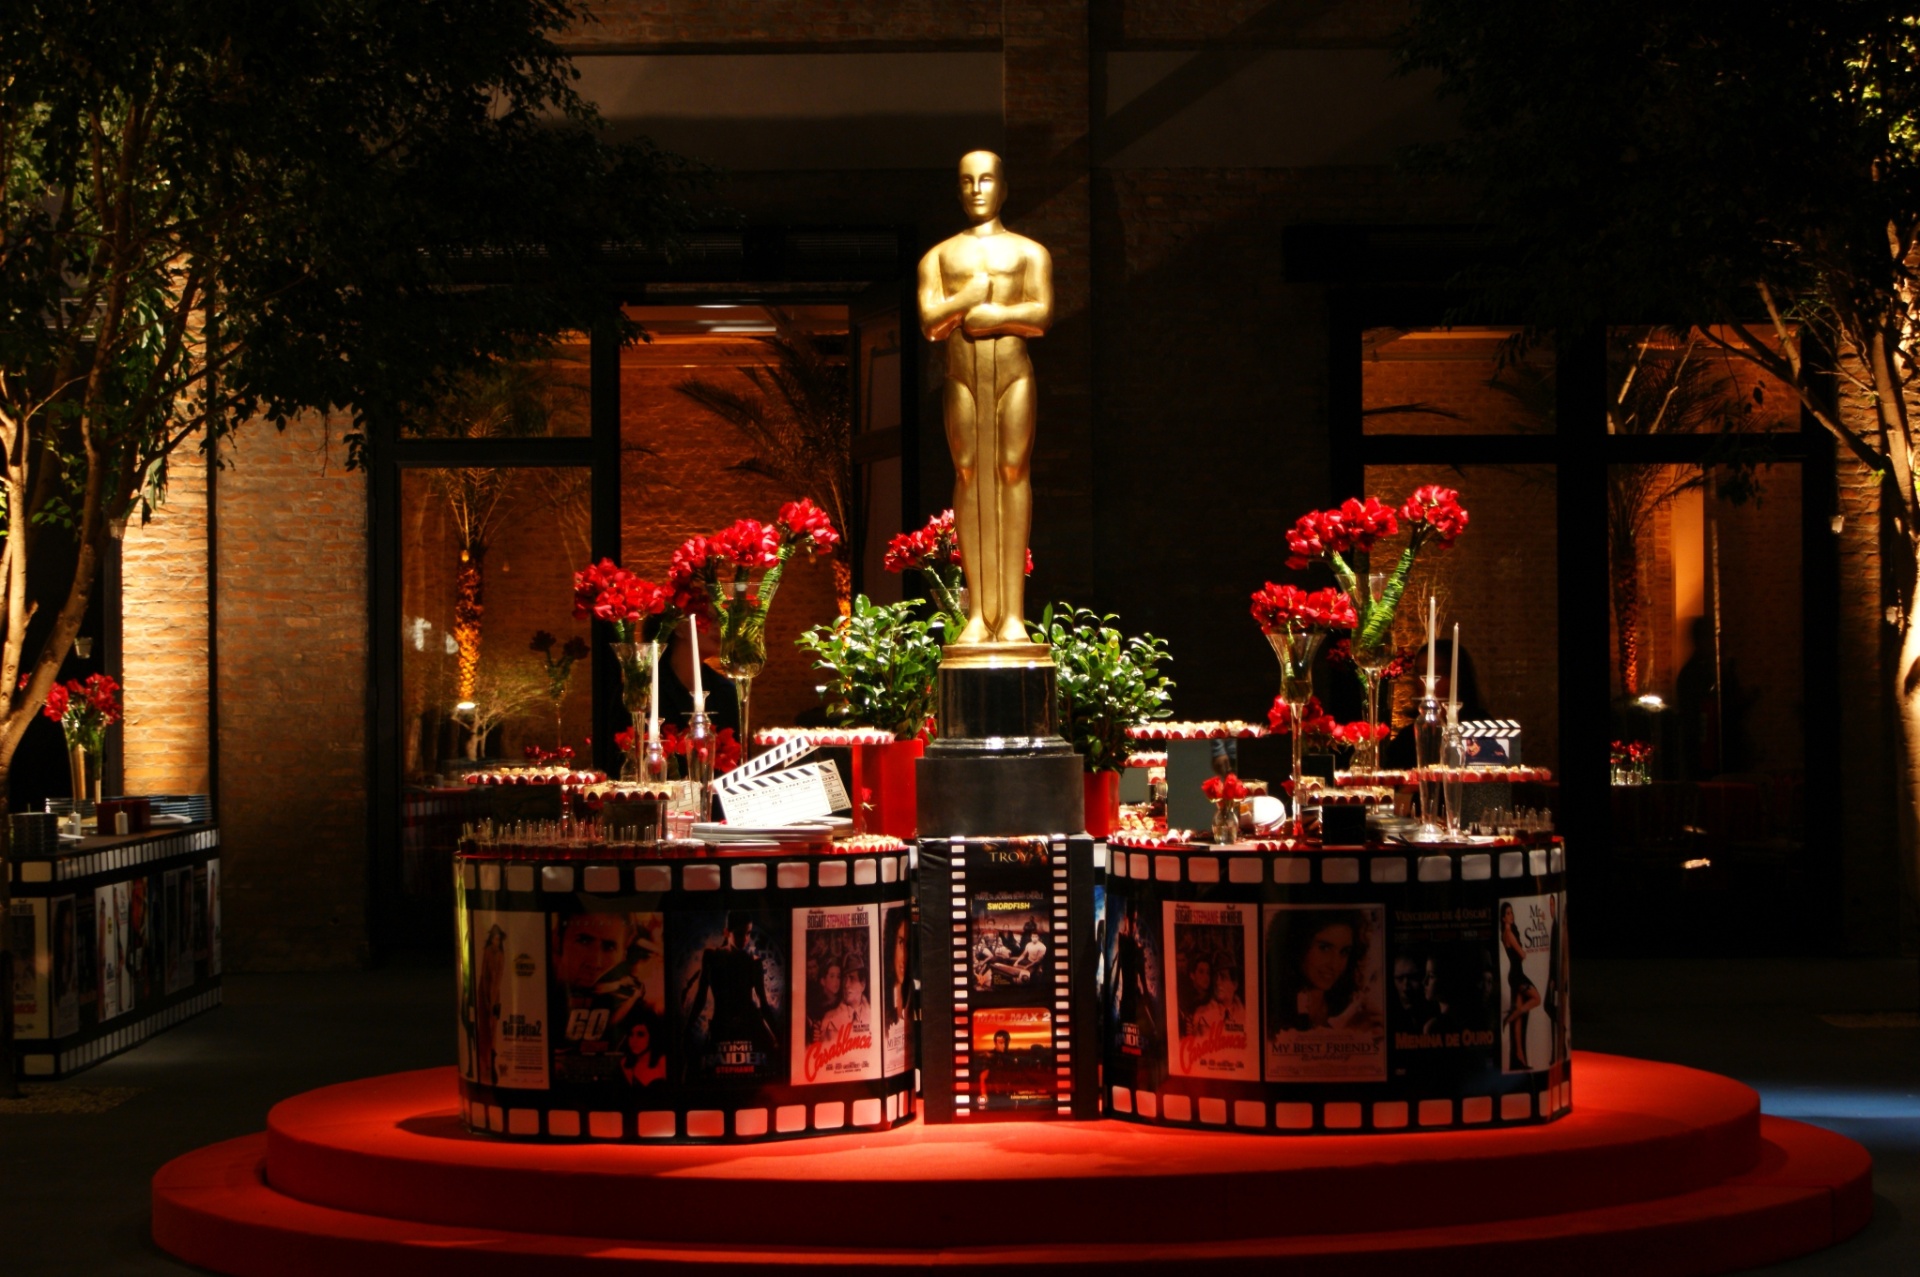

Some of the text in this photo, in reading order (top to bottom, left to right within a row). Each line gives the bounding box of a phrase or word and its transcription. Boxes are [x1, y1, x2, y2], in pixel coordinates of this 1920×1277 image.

[989, 851, 1029, 864] TROY
[987, 901, 1031, 911] SWORDFISH
[977, 1012, 1051, 1023] MAD MAX 2
[1394, 1028, 1495, 1050] MENINA DE OURO
[1272, 1043, 1290, 1054] MY
[1293, 1043, 1322, 1054] BEST
